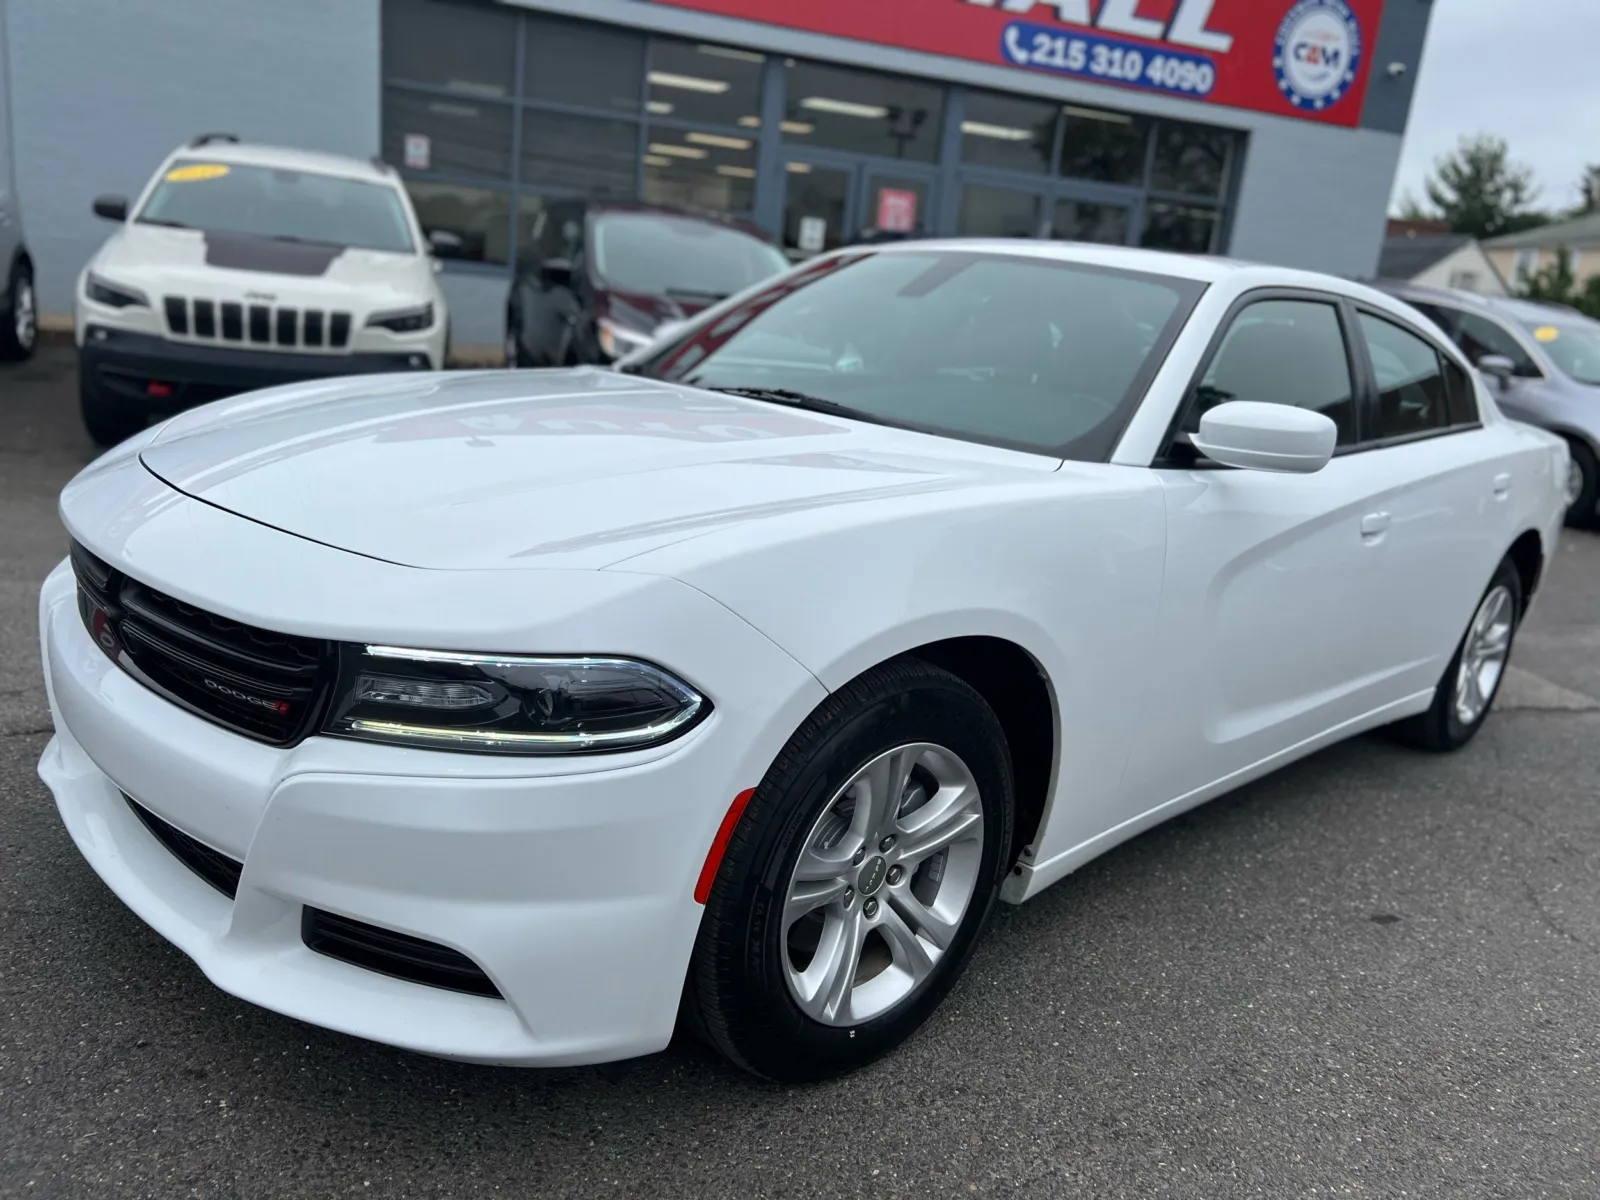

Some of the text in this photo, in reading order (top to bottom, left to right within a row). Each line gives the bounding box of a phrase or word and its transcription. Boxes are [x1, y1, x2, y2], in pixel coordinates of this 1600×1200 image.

[963, 0, 1235, 53] LL
[1032, 32, 1215, 94] 215 310 4090
[203, 678, 279, 712] DODGE
